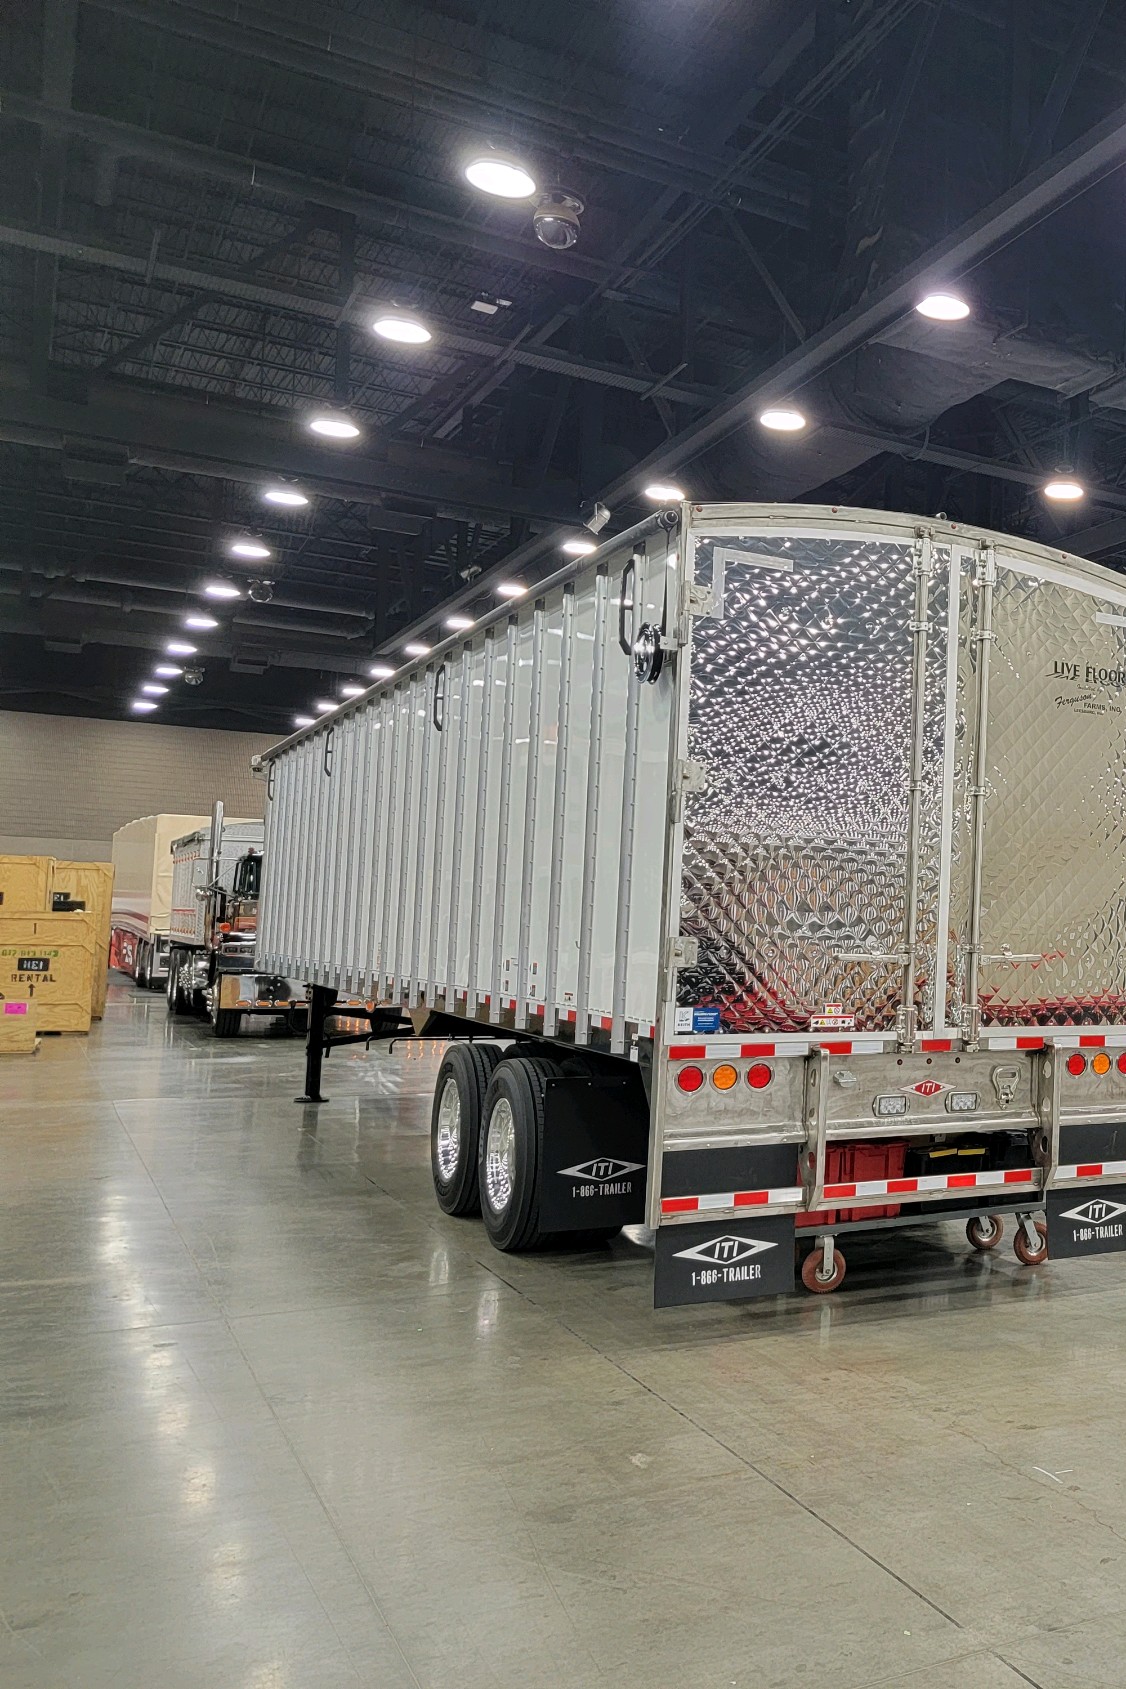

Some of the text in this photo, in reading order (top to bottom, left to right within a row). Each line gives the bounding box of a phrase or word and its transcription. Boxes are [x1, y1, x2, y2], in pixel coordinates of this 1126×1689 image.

[1054, 660, 1126, 684] LIVE FLOOR
[11, 973, 56, 983] RENTAL
[921, 1083, 936, 1093] ITI
[592, 1162, 613, 1177] ITI
[572, 1181, 632, 1198] 1-866-TRAILER
[1088, 1203, 1107, 1218] ITI
[1073, 1223, 1124, 1242] 1-866-TRAILER
[714, 1240, 739, 1259] ITI
[691, 1264, 762, 1287] 1-866-TRAILER
